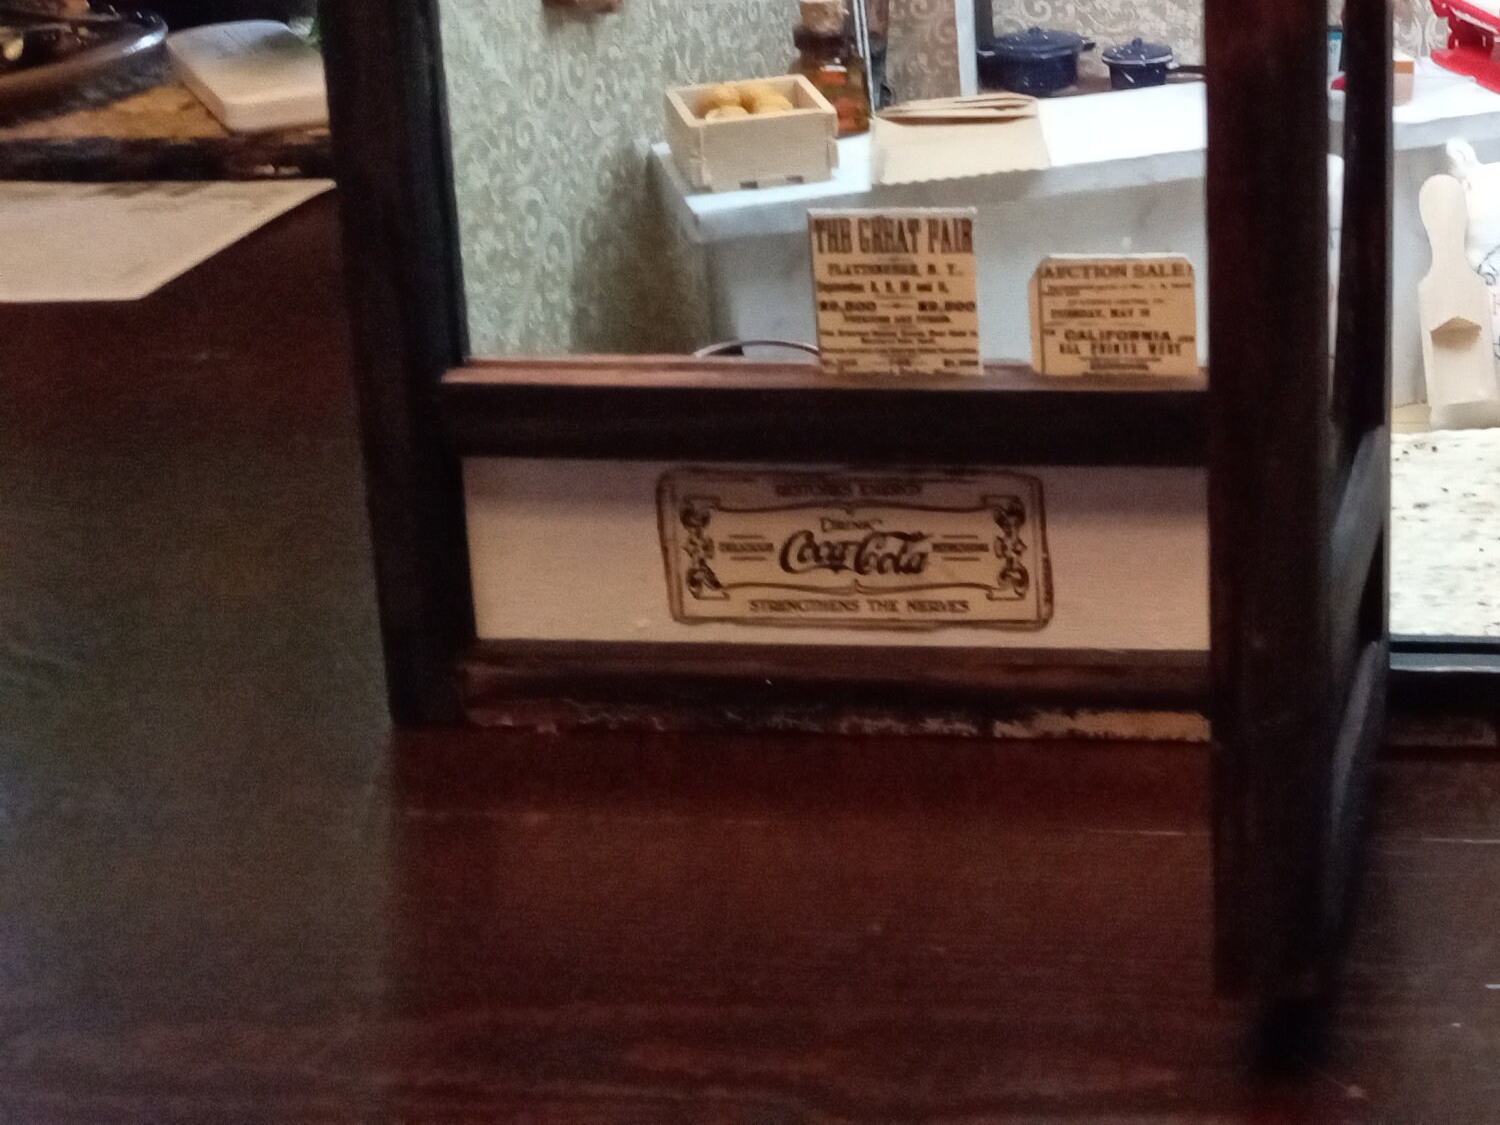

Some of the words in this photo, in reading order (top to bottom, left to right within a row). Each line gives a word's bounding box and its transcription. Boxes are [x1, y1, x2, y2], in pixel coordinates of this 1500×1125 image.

[815, 218, 852, 254] THE
[858, 216, 918, 254] GREAT
[928, 218, 973, 254] FAIR
[1040, 264, 1128, 279] AUCTION
[1064, 329, 1171, 342] CALIFORNIA
[749, 598, 859, 613] STRENGTHENS
[867, 598, 898, 613] THE
[907, 598, 969, 613] NERVES
